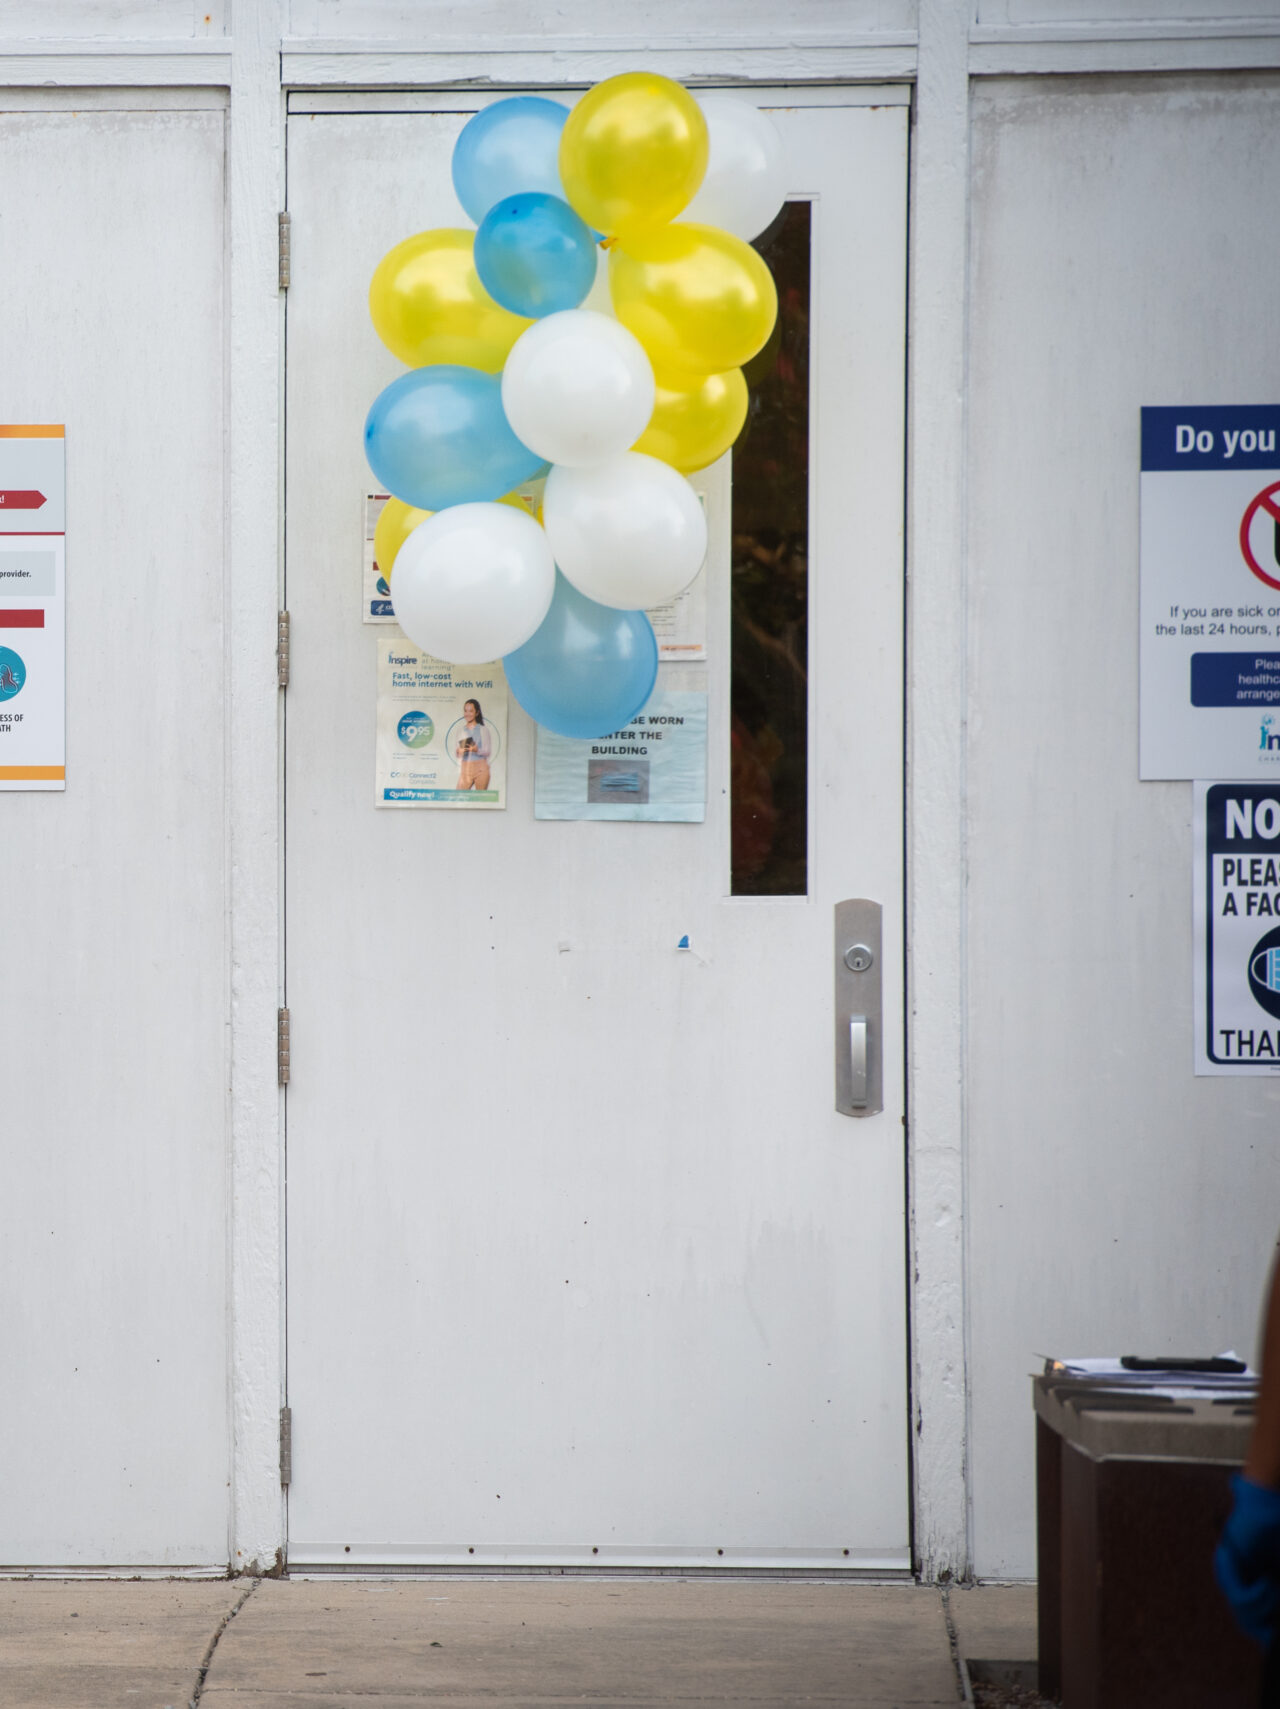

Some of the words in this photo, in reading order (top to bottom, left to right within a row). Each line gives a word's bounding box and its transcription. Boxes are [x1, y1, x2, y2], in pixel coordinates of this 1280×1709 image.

[1176, 425, 1213, 452] Do
[1223, 430, 1275, 458] you
[0, 570, 31, 579] provider.
[1171, 606, 1179, 617] If
[1182, 608, 1207, 620] you
[1211, 608, 1233, 617] are
[1238, 606, 1263, 617] sick
[1156, 624, 1176, 635] the
[1181, 624, 1204, 635] last
[1209, 623, 1224, 635] 24
[1230, 624, 1271, 636] hours,
[392, 672, 413, 681] Fast,
[415, 672, 452, 680] low-cost
[418, 680, 452, 688] internet
[455, 680, 474, 688] with
[476, 680, 493, 688] Wifi
[648, 716, 684, 725] WORN
[599, 731, 636, 740] NTER
[639, 732, 663, 740] THE
[591, 746, 648, 755] BUILDING
[389, 791, 417, 799] Qualify
[1222, 858, 1280, 887] PLEA
[1222, 892, 1238, 917] A
[1220, 1029, 1280, 1057] THA
